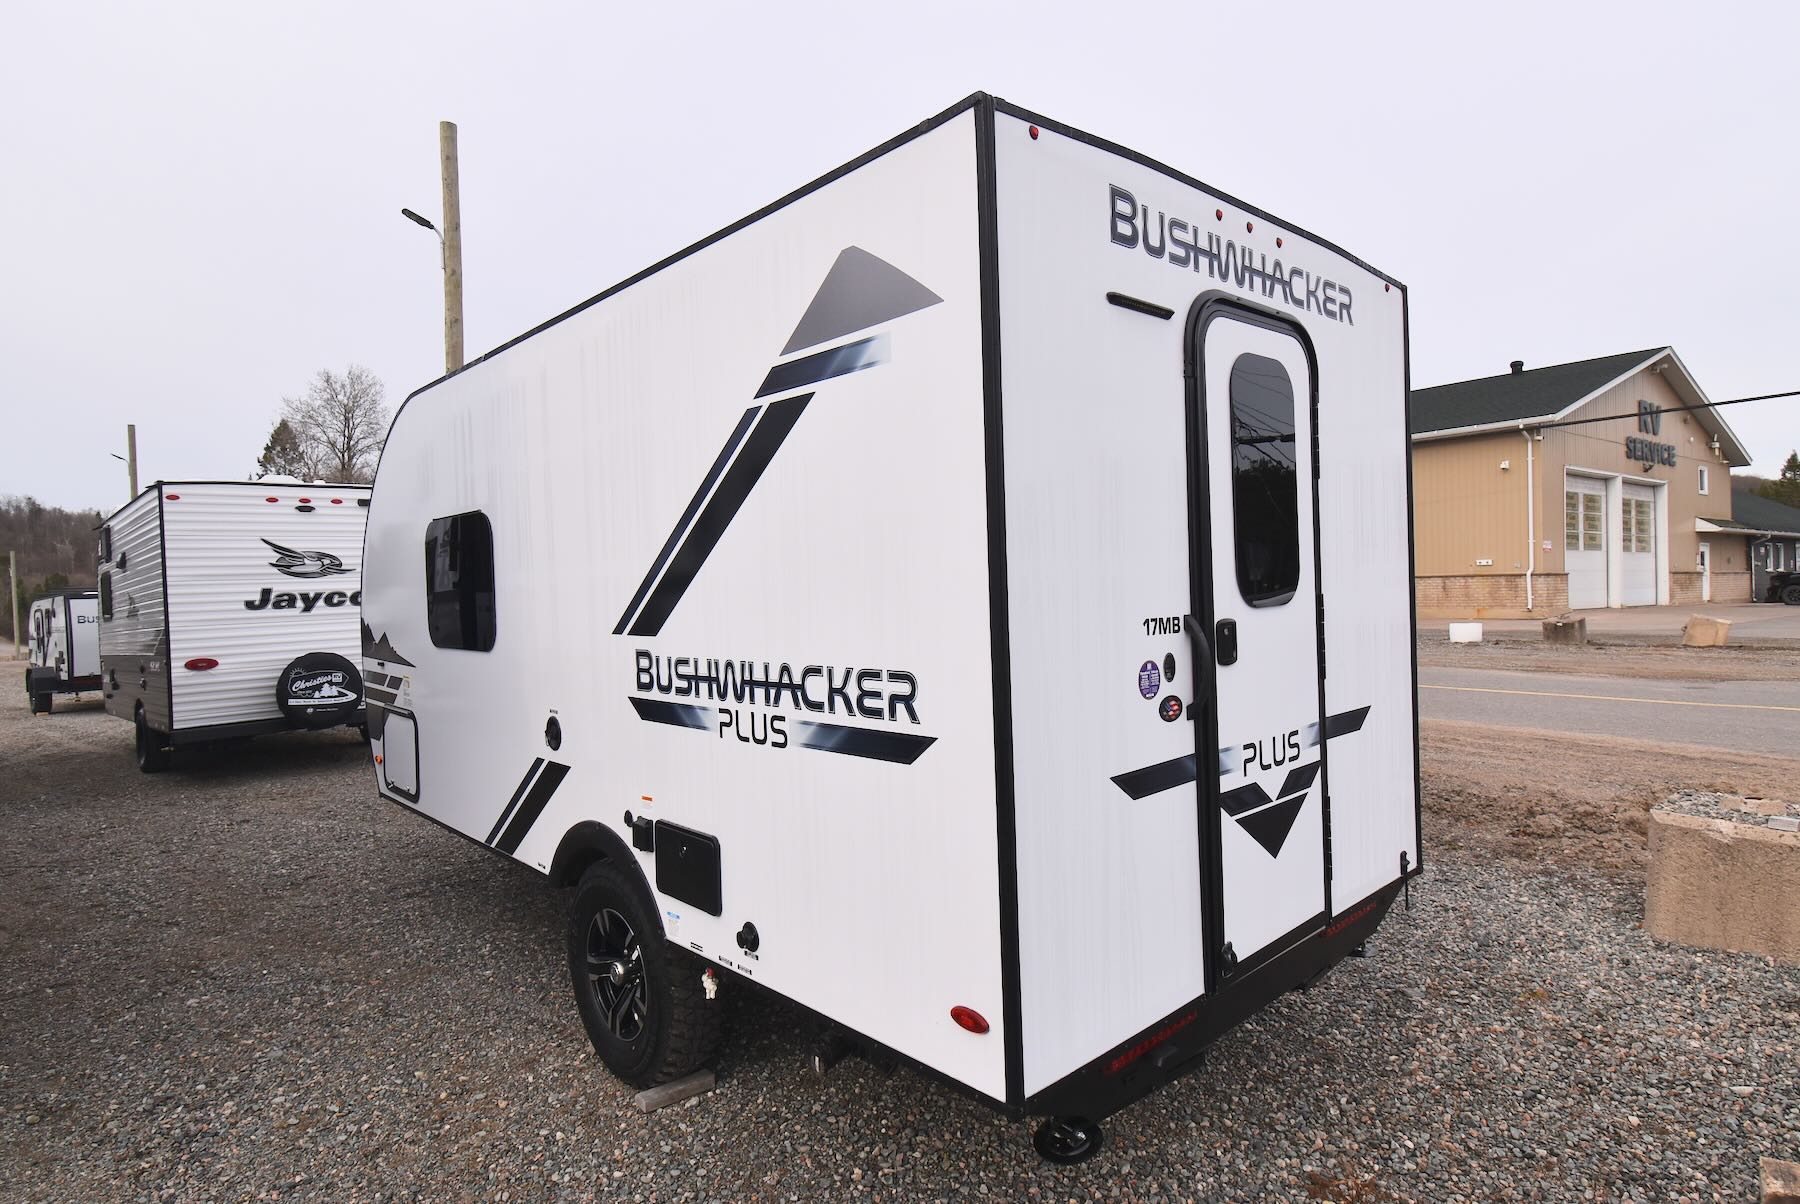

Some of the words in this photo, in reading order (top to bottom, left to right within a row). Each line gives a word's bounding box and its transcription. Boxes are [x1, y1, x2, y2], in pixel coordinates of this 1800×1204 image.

[1109, 183, 1354, 327] BUSHWHACKER
[1638, 399, 1661, 435] RV
[1626, 436, 1677, 467] SERVICE
[1143, 616, 1181, 636] 17MB
[292, 674, 332, 692] Christies
[635, 648, 920, 725] BUSHWHACKER
[718, 708, 788, 749] PLUS
[1243, 729, 1300, 777] PLUS
